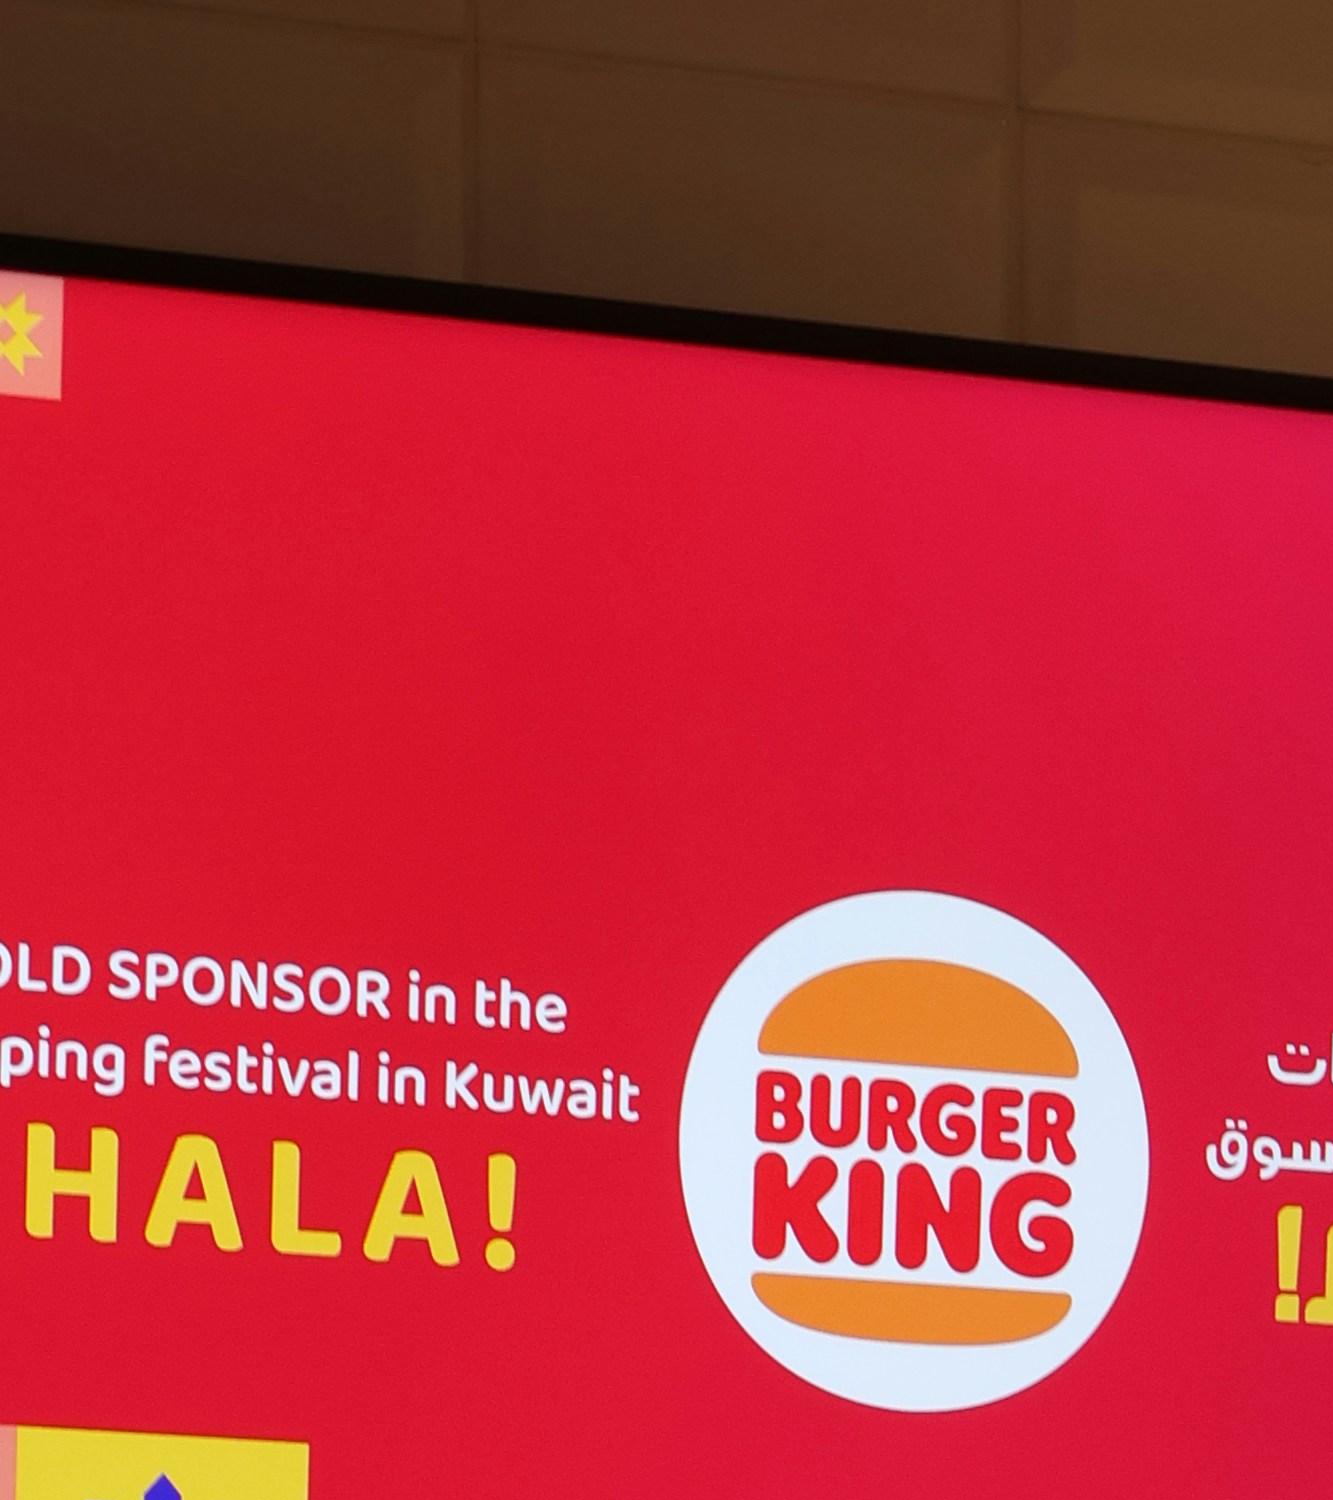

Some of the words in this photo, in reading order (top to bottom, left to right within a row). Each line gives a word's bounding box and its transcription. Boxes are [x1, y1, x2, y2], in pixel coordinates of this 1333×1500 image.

[108, 950, 391, 1020] SPONSOR
[408, 970, 457, 1025] in
[474, 979, 569, 1034] the
[143, 1033, 360, 1102] festival
[377, 1052, 427, 1107] in
[445, 1061, 640, 1123] Kuwait
[755, 1069, 1077, 1166] BURGER
[25, 1121, 518, 1273] HALA!
[752, 1151, 1075, 1279] KING
